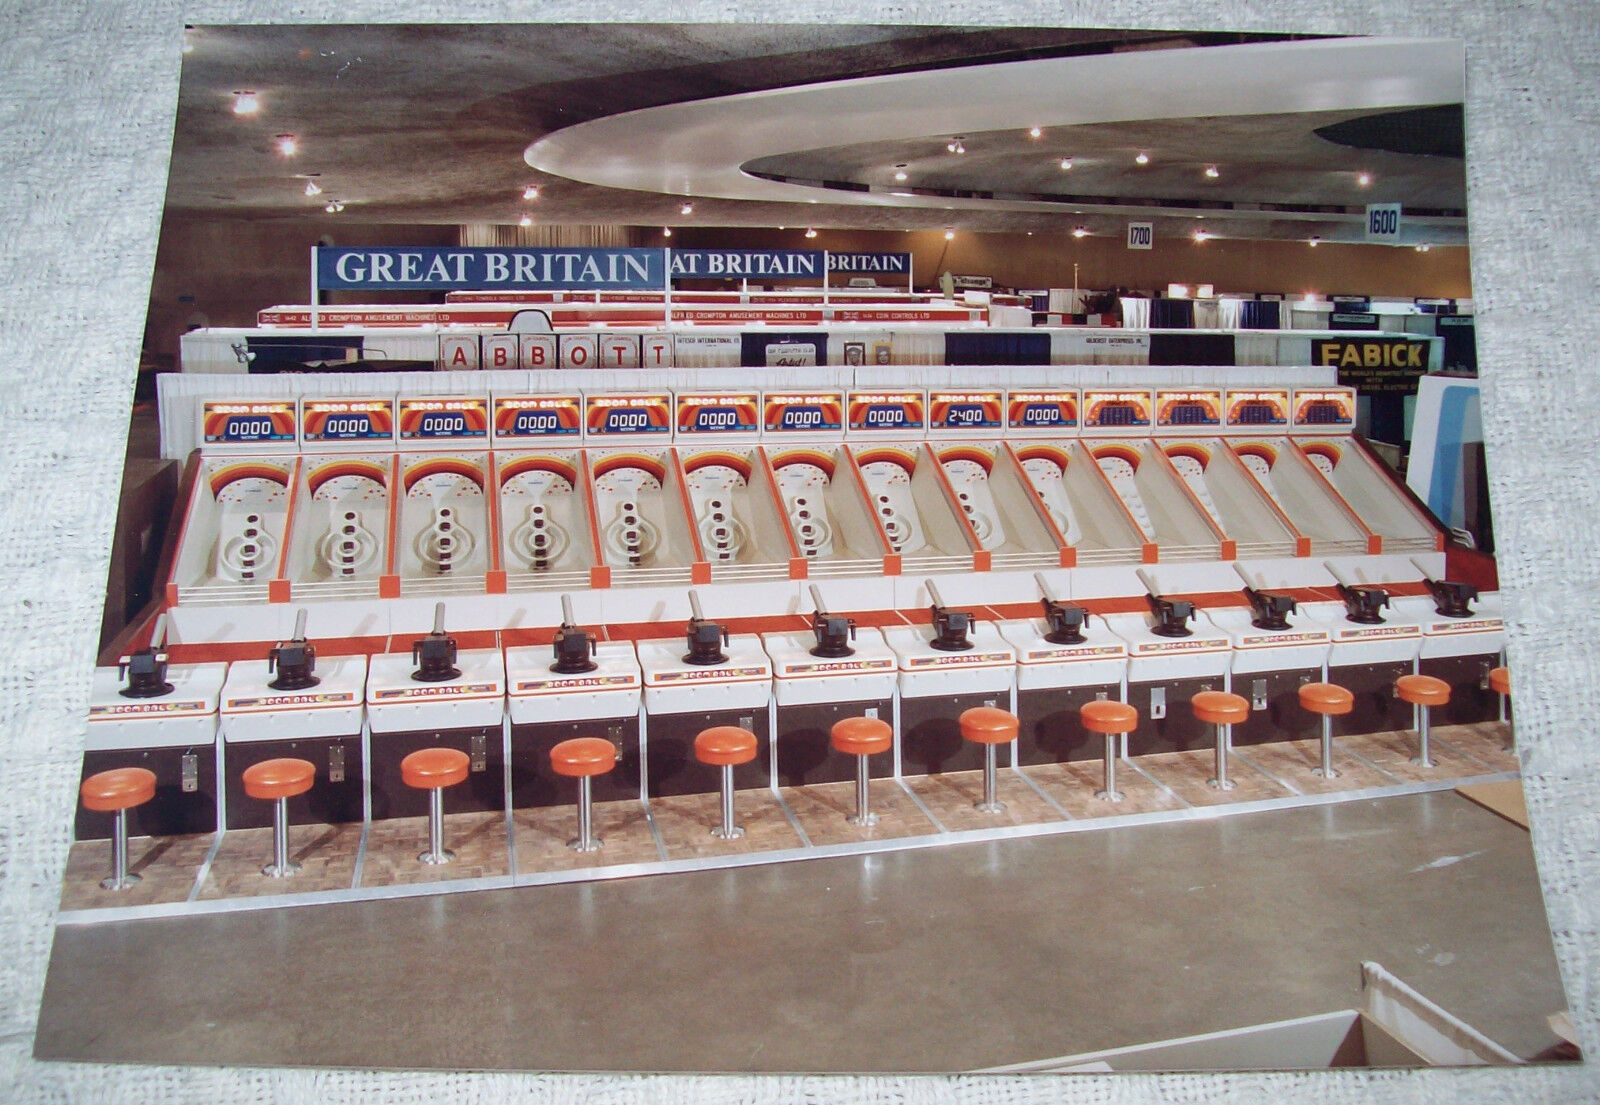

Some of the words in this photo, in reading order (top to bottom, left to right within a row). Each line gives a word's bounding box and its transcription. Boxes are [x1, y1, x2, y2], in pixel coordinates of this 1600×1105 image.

[1370, 210, 1397, 234] 1600
[1130, 226, 1150, 245] 1700
[336, 252, 474, 282] GREAT
[484, 253, 650, 282] BRITAIN
[708, 254, 816, 274] BRITAIN
[828, 255, 904, 271] BRITAIN
[1322, 344, 1423, 367] FABICK
[610, 414, 647, 427] 0000
[699, 413, 736, 425] 0000
[785, 412, 821, 424] 0000
[869, 410, 903, 422] 0000
[949, 410, 982, 422] 2400
[1026, 409, 1059, 420] 0000
[229, 421, 271, 435] 0000
[328, 419, 369, 433] 0000
[424, 418, 464, 431] 0000
[518, 416, 557, 429] 0000
